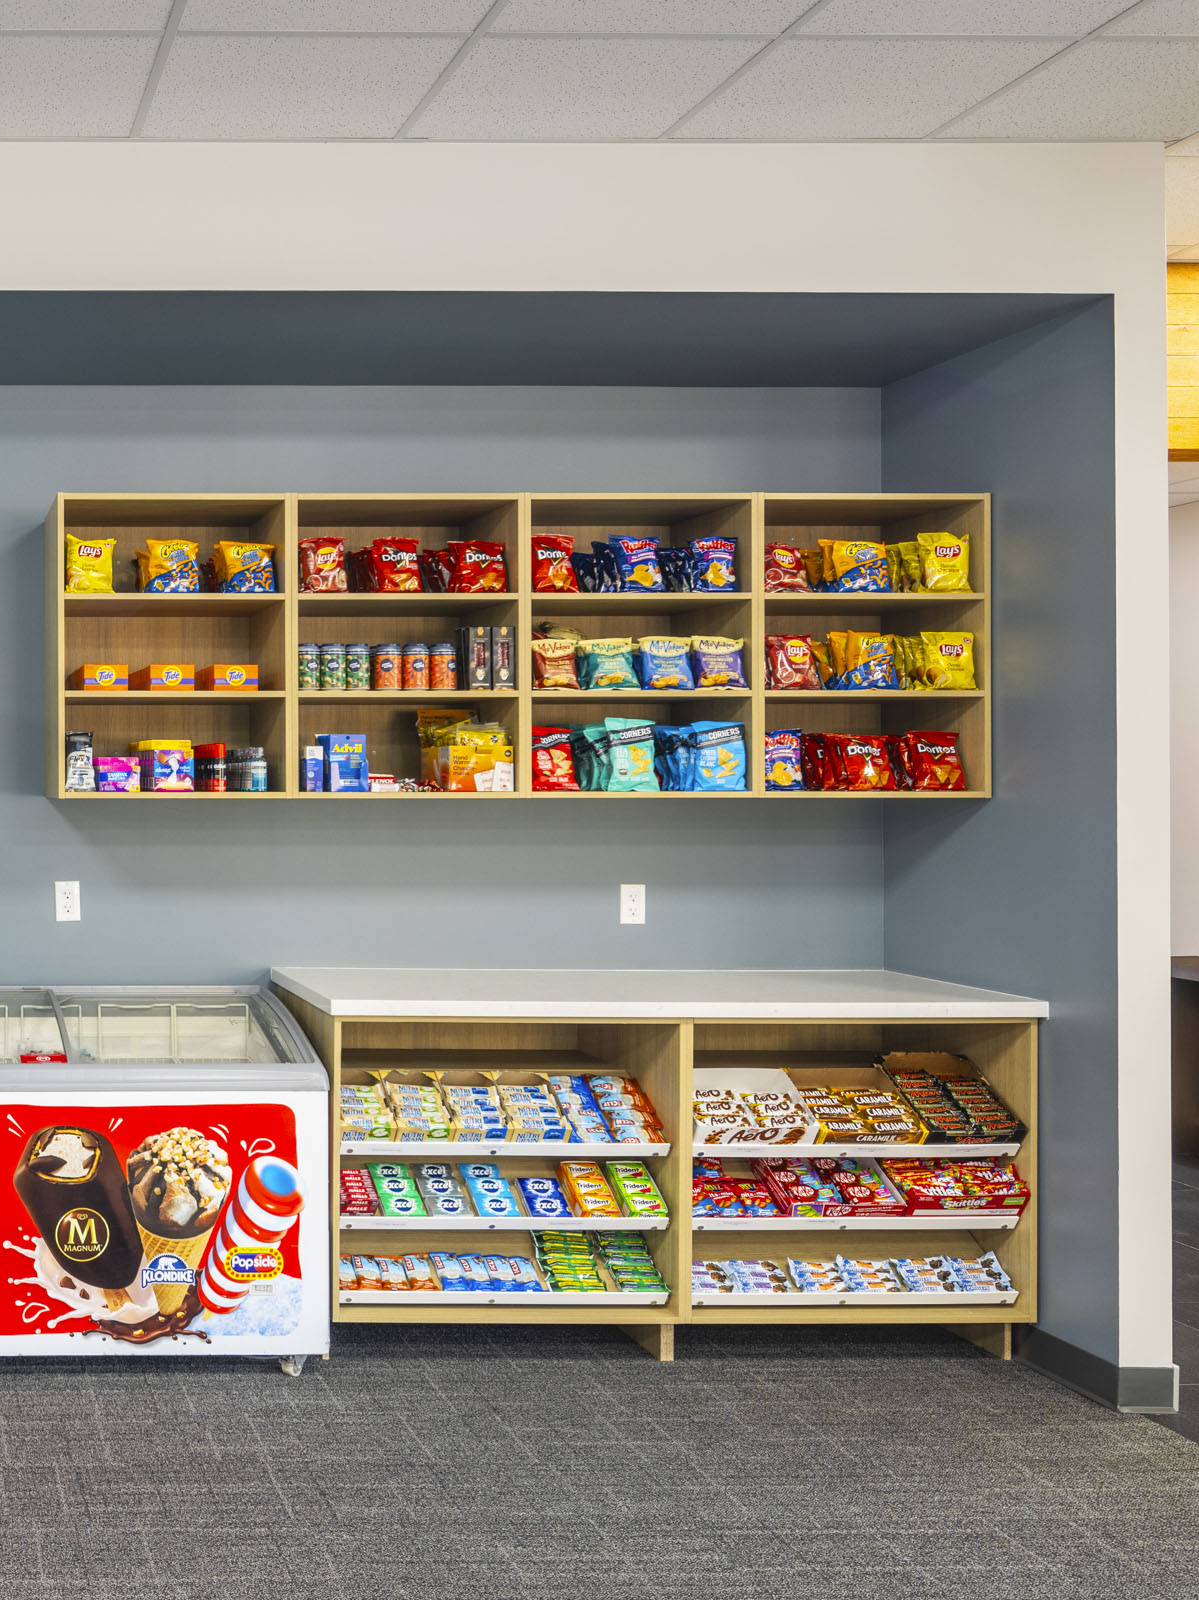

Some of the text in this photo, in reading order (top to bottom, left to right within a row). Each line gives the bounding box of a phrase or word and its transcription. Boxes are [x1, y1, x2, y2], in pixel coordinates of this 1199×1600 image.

[621, 540, 657, 554] Ruffles
[936, 544, 961, 558] Lay's
[381, 552, 418, 563] Doritos
[465, 551, 503, 563] Doritos
[787, 645, 809, 657] Lay's
[941, 644, 964, 656] Lay's
[98, 671, 114, 681] Tide
[164, 671, 180, 681] Tide
[228, 671, 244, 681] Tide
[331, 744, 363, 753] Advil
[847, 744, 881, 756] Doritos
[917, 743, 956, 755] Doritos
[805, 1097, 840, 1105] ARAMILK
[854, 1095, 893, 1104] CARAMILK
[814, 1106, 853, 1114] CARAMILK
[866, 1108, 907, 1116] CARAMILK
[828, 1121, 863, 1130] ARAMILK
[874, 1122, 914, 1131] CARAMILK
[377, 1165, 400, 1175] excel
[422, 1165, 445, 1175] excel
[469, 1166, 492, 1176] excel
[384, 1179, 407, 1189] excel
[429, 1179, 451, 1189] excel
[479, 1179, 502, 1190] excel
[528, 1180, 552, 1190] excel
[391, 1198, 415, 1208] excel
[438, 1198, 461, 1208] excel
[486, 1198, 509, 1208] excel
[536, 1199, 560, 1209] excel
[943, 1198, 987, 1209] Skittles
[69, 1217, 98, 1244] M
[64, 1243, 101, 1253] MAGNUM
[231, 1255, 278, 1271] Popsicle
[142, 1270, 194, 1287] KLONDIKE
